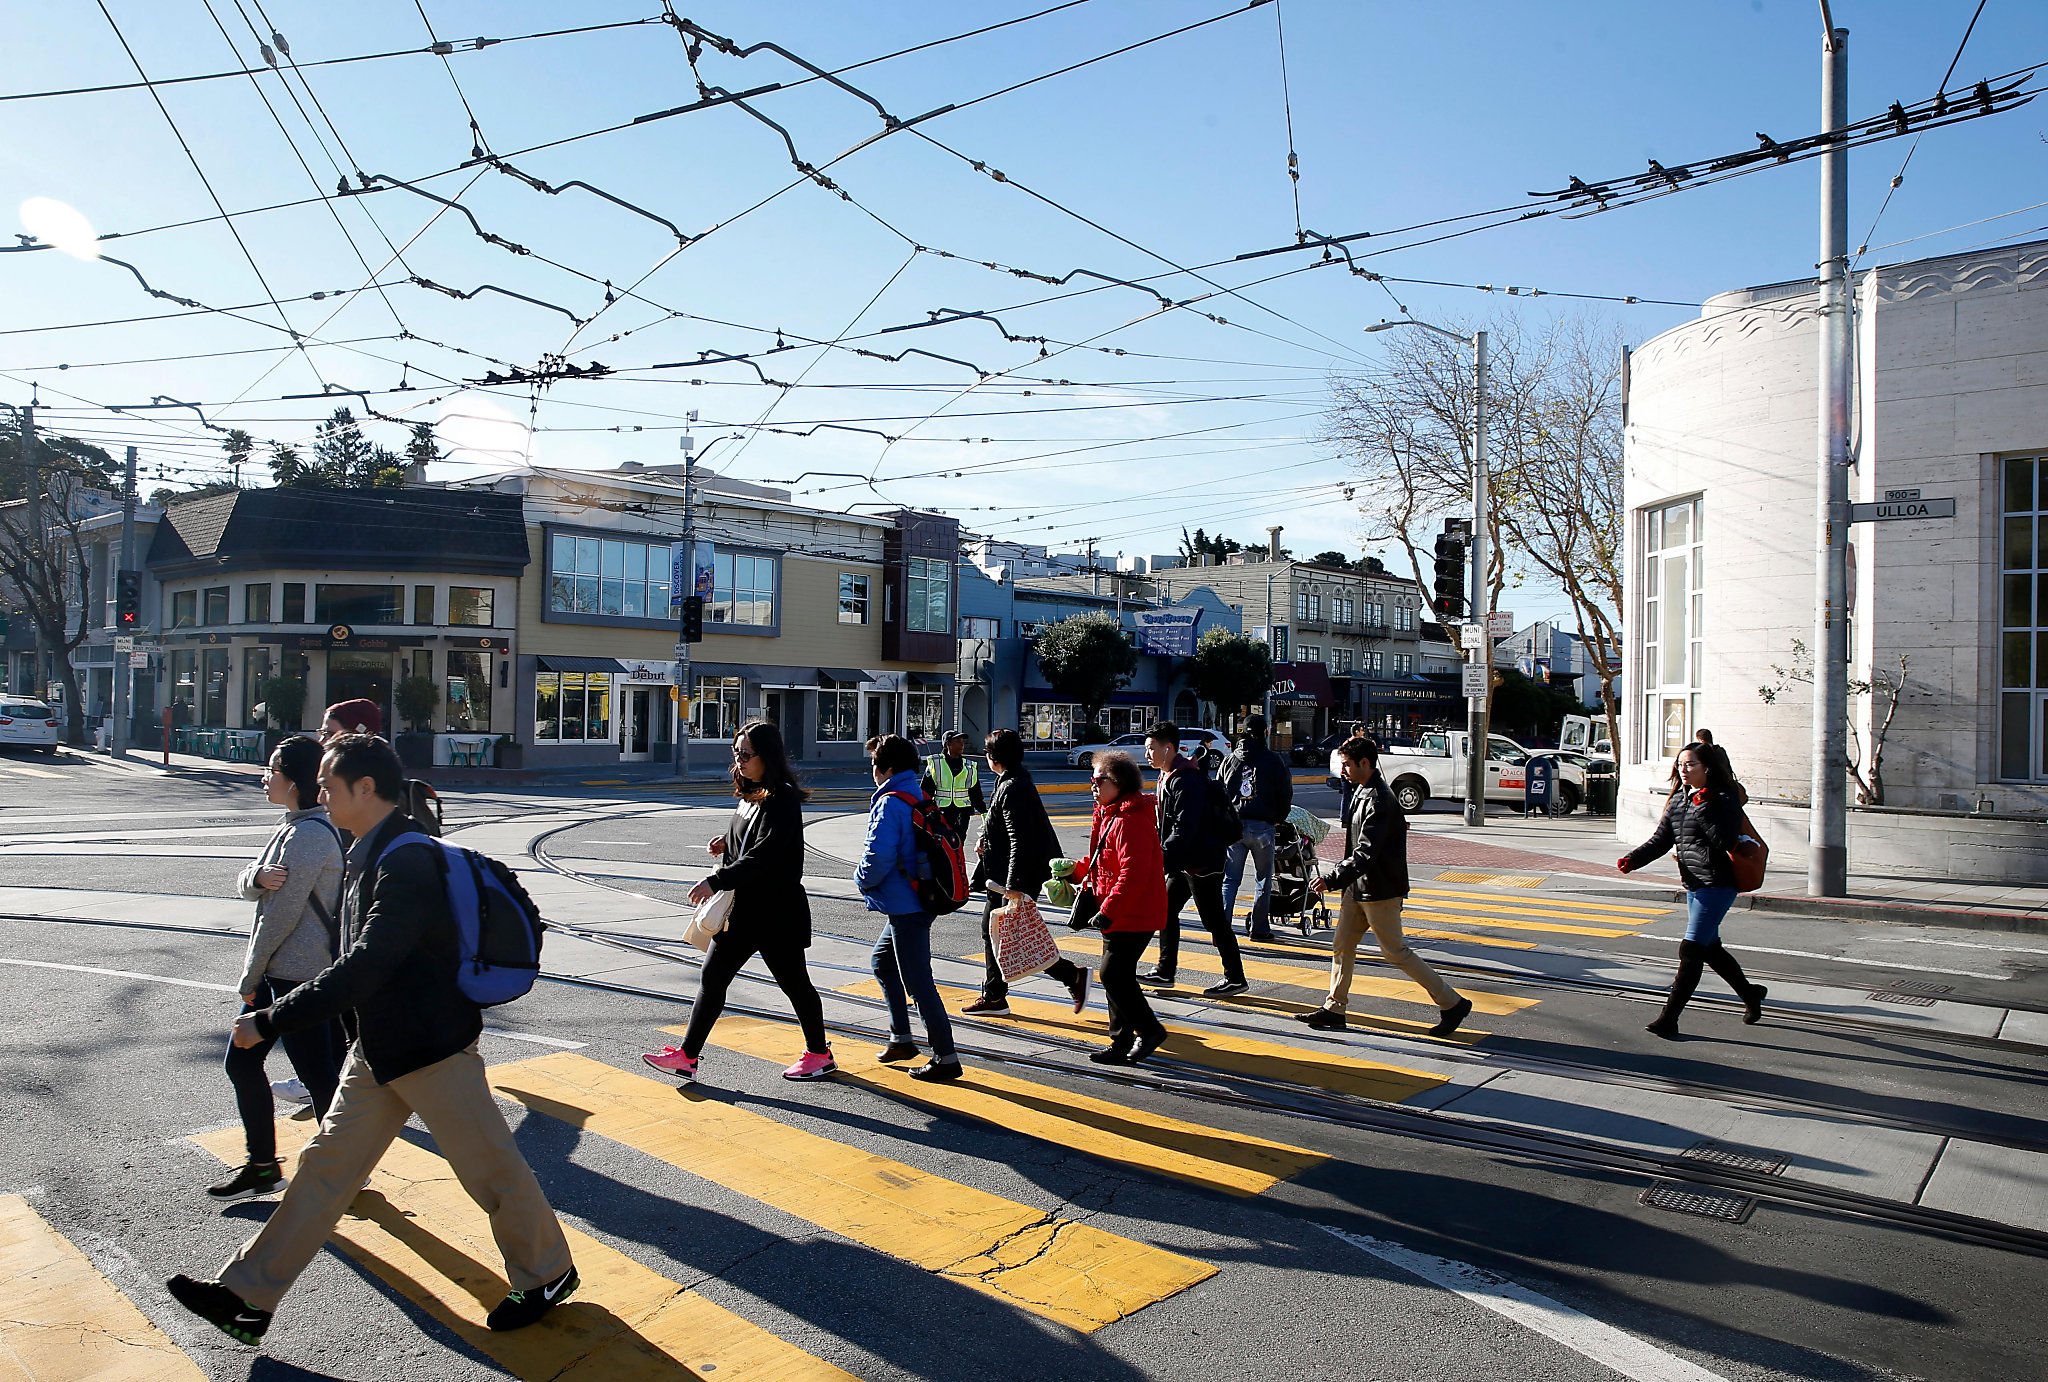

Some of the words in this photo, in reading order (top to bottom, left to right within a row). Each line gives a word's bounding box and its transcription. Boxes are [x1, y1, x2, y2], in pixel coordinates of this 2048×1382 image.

[1888, 491, 1908, 499] 900
[1876, 504, 1929, 518] ULLOA
[1489, 612, 1496, 620] NO
[631, 670, 667, 681] Debut
[1292, 699, 1318, 707] ITALIANA
[1024, 945, 1045, 958] LONDON
[1022, 956, 1038, 967] SEOUL
